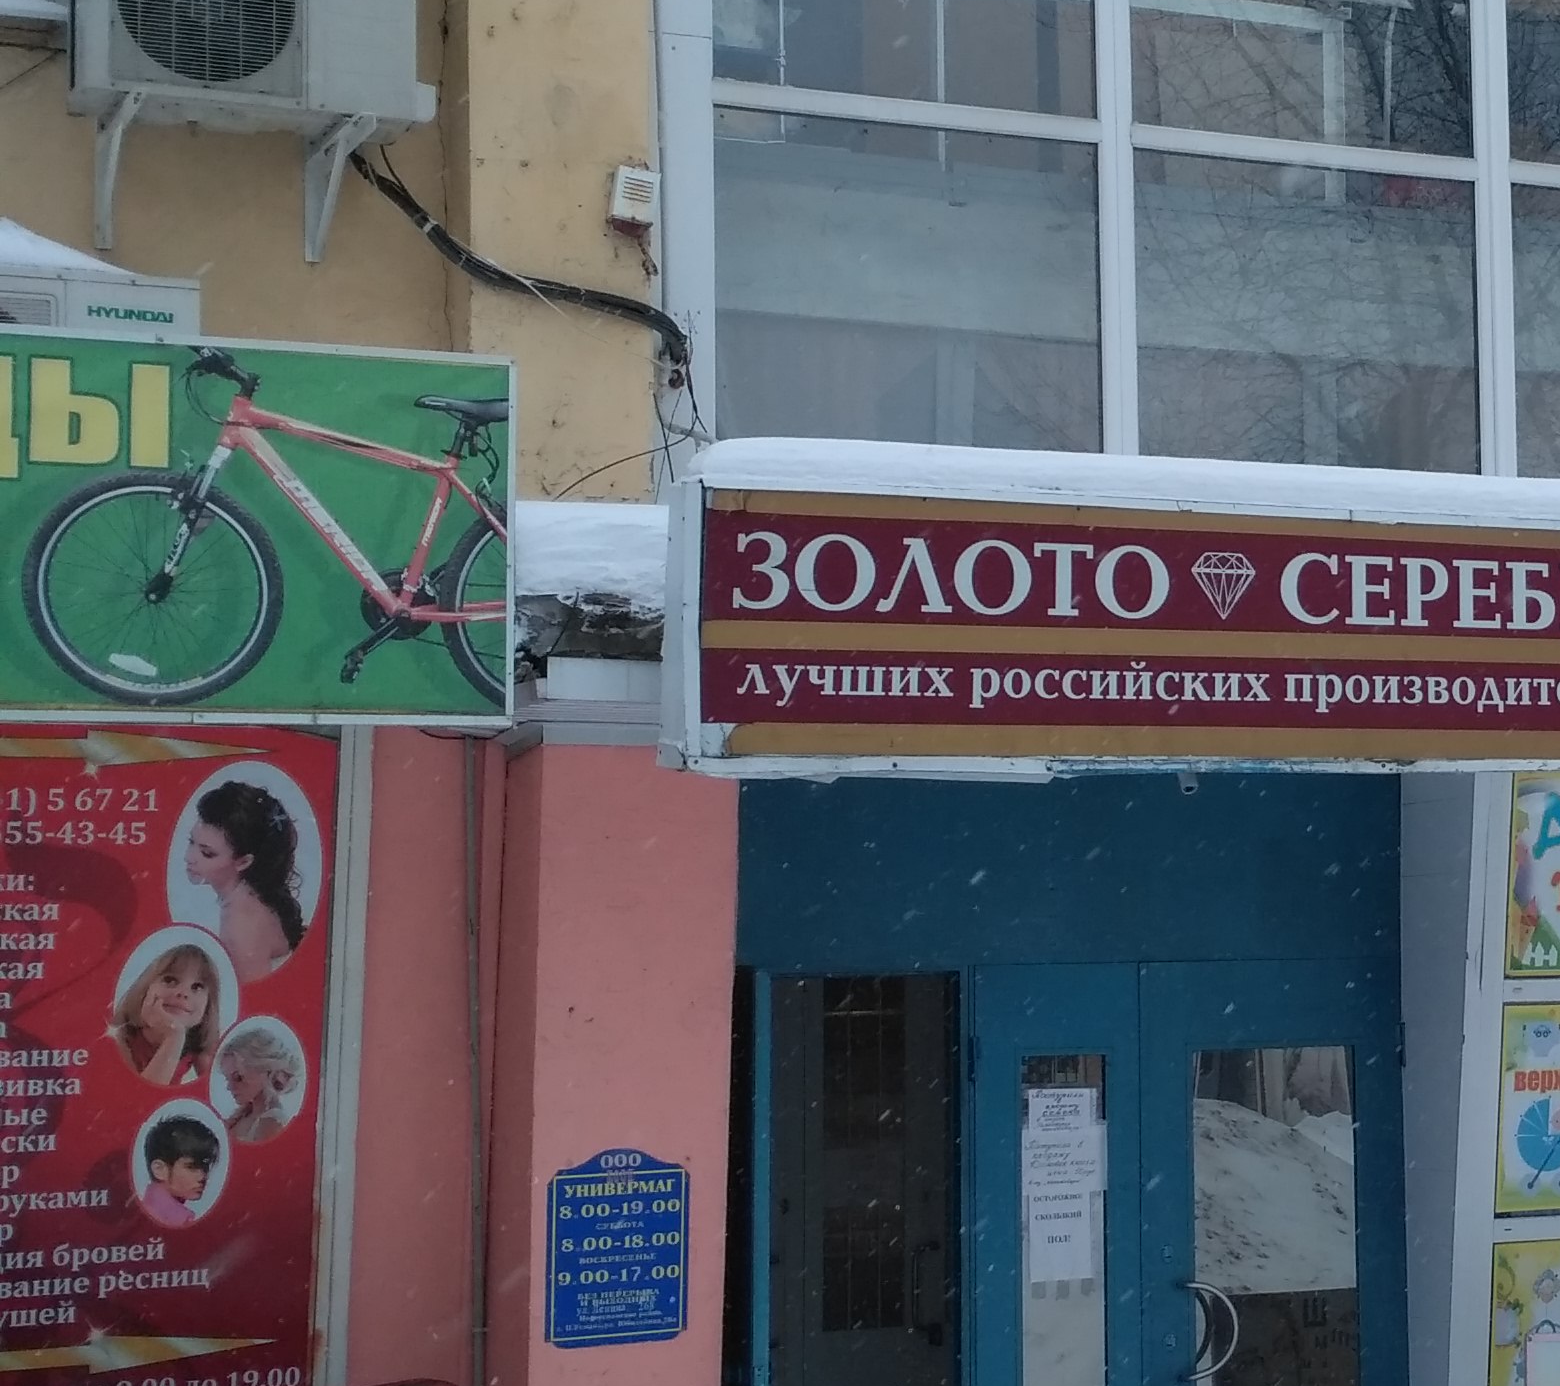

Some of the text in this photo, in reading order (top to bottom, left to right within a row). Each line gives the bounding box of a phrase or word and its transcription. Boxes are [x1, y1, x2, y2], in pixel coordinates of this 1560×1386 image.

[87, 304, 174, 324] HYUNDAI
[733, 530, 1171, 620] ЗОЛОТО
[737, 661, 954, 701] лучших
[970, 659, 1271, 711] российских
[0, 787, 158, 816] 1) 5 67 21
[0, 822, 146, 845] 55-43-45
[563, 1179, 675, 1198] УНИВЕРМАГ
[53, 1237, 165, 1271] бровей
[99, 1267, 210, 1298] ресниц
